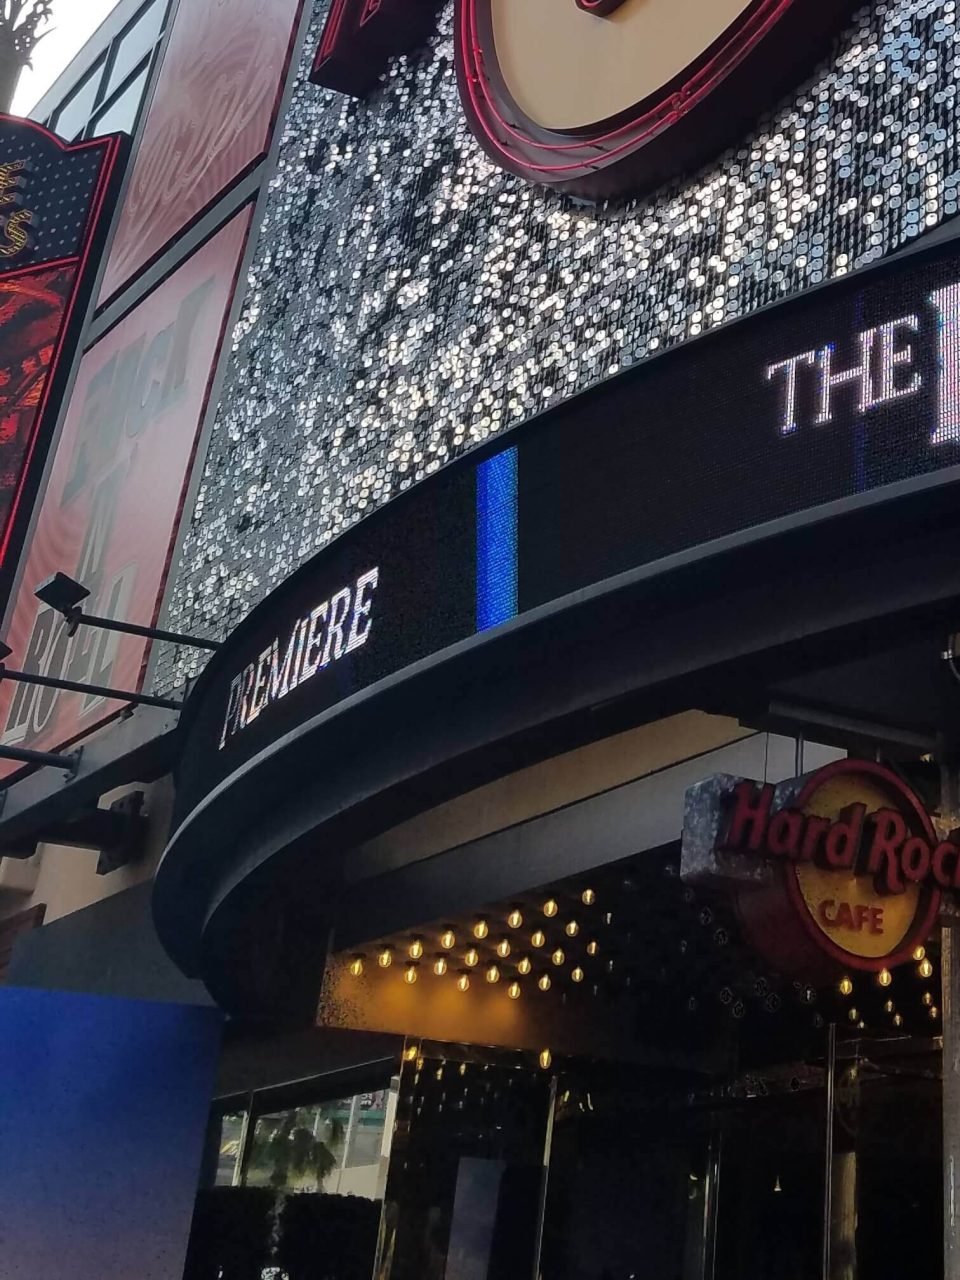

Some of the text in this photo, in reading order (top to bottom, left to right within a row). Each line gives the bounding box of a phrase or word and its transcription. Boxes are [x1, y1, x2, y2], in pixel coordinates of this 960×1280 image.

[766, 314, 923, 436] THE
[218, 566, 380, 751] PREMIERE
[724, 778, 868, 870] Hard
[819, 898, 885, 936] CAFE
